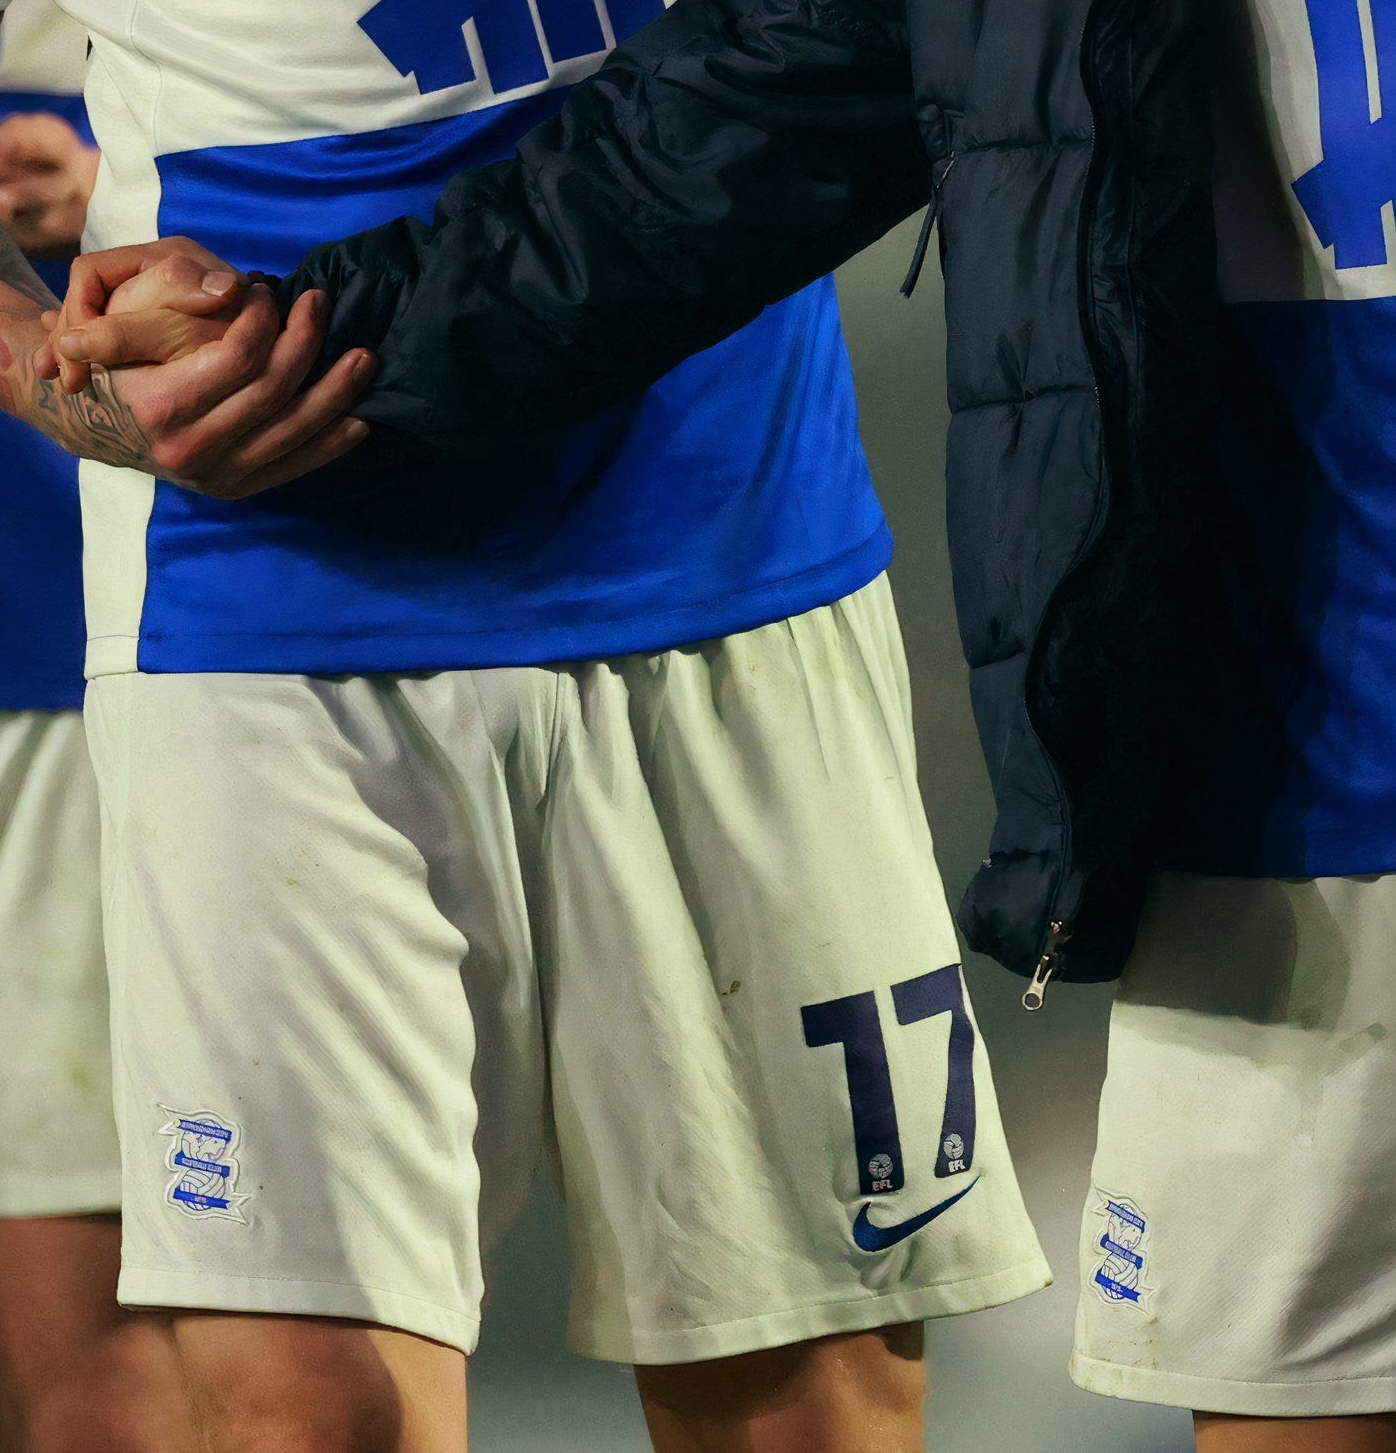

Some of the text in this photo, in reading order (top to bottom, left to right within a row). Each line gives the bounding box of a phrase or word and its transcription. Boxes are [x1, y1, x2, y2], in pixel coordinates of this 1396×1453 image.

[800, 963, 976, 1195] 17
[948, 1159, 966, 1173] EFL
[872, 1179, 893, 1192] EFL
